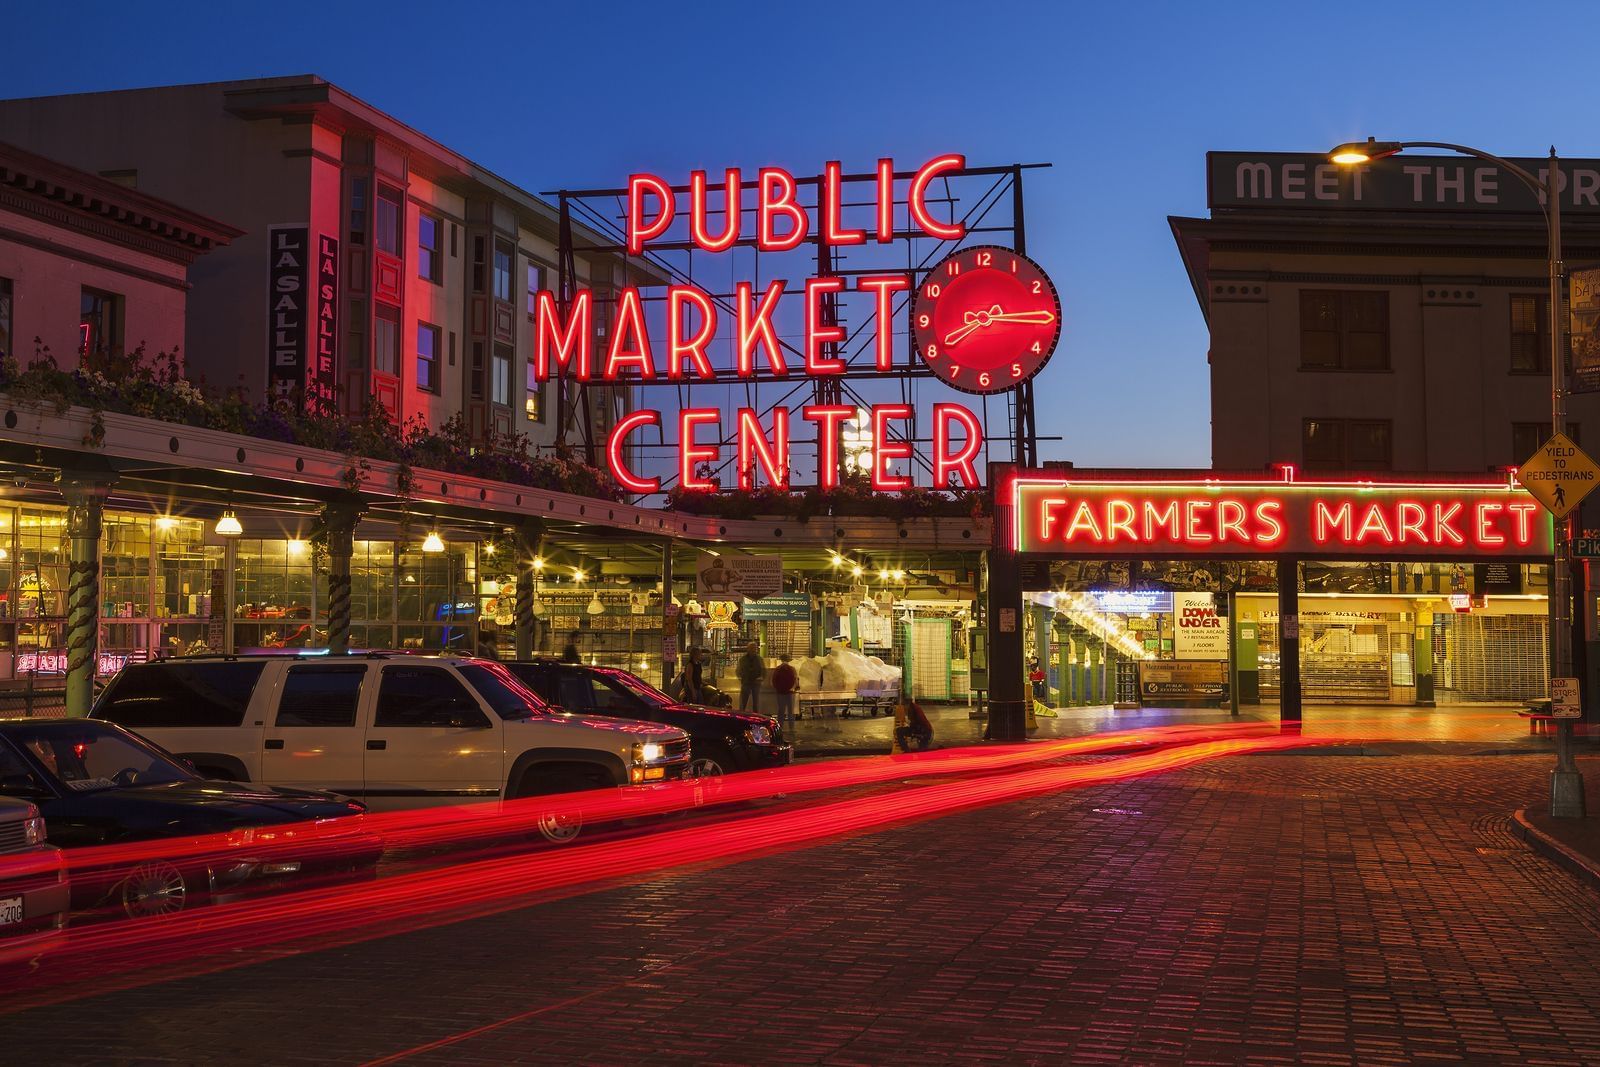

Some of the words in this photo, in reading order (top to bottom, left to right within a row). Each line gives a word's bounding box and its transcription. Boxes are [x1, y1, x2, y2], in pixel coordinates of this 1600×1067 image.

[1236, 161, 1371, 201] MEET
[1403, 165, 1499, 203] THE
[627, 154, 966, 257] PUBLIC
[276, 234, 299, 268] LA
[321, 239, 335, 276] LA
[976, 252, 991, 266] 12
[948, 262, 959, 275] 11
[926, 284, 941, 298] 10
[1031, 280, 1042, 294] 2
[274, 275, 300, 366] SALLE
[919, 314, 930, 328] 9
[319, 284, 334, 373] SALLE
[535, 273, 914, 383] MARKET
[927, 344, 937, 358] 8
[1031, 341, 1042, 354] 4
[950, 365, 960, 378] 7
[1012, 363, 1022, 377] 5
[979, 372, 990, 386] 6
[607, 402, 983, 493] CENTER
[1545, 447, 1575, 457] YIELD
[1553, 459, 1566, 469] TO
[1526, 470, 1594, 481] PEDESTRIANS
[1041, 499, 1281, 541] FARMERS
[1317, 502, 1537, 543] MARKET
[1184, 599, 1216, 607] Welco
[1179, 618, 1221, 628] UNDER
[1552, 679, 1564, 687] NO
[1553, 689, 1577, 697] STOPS
